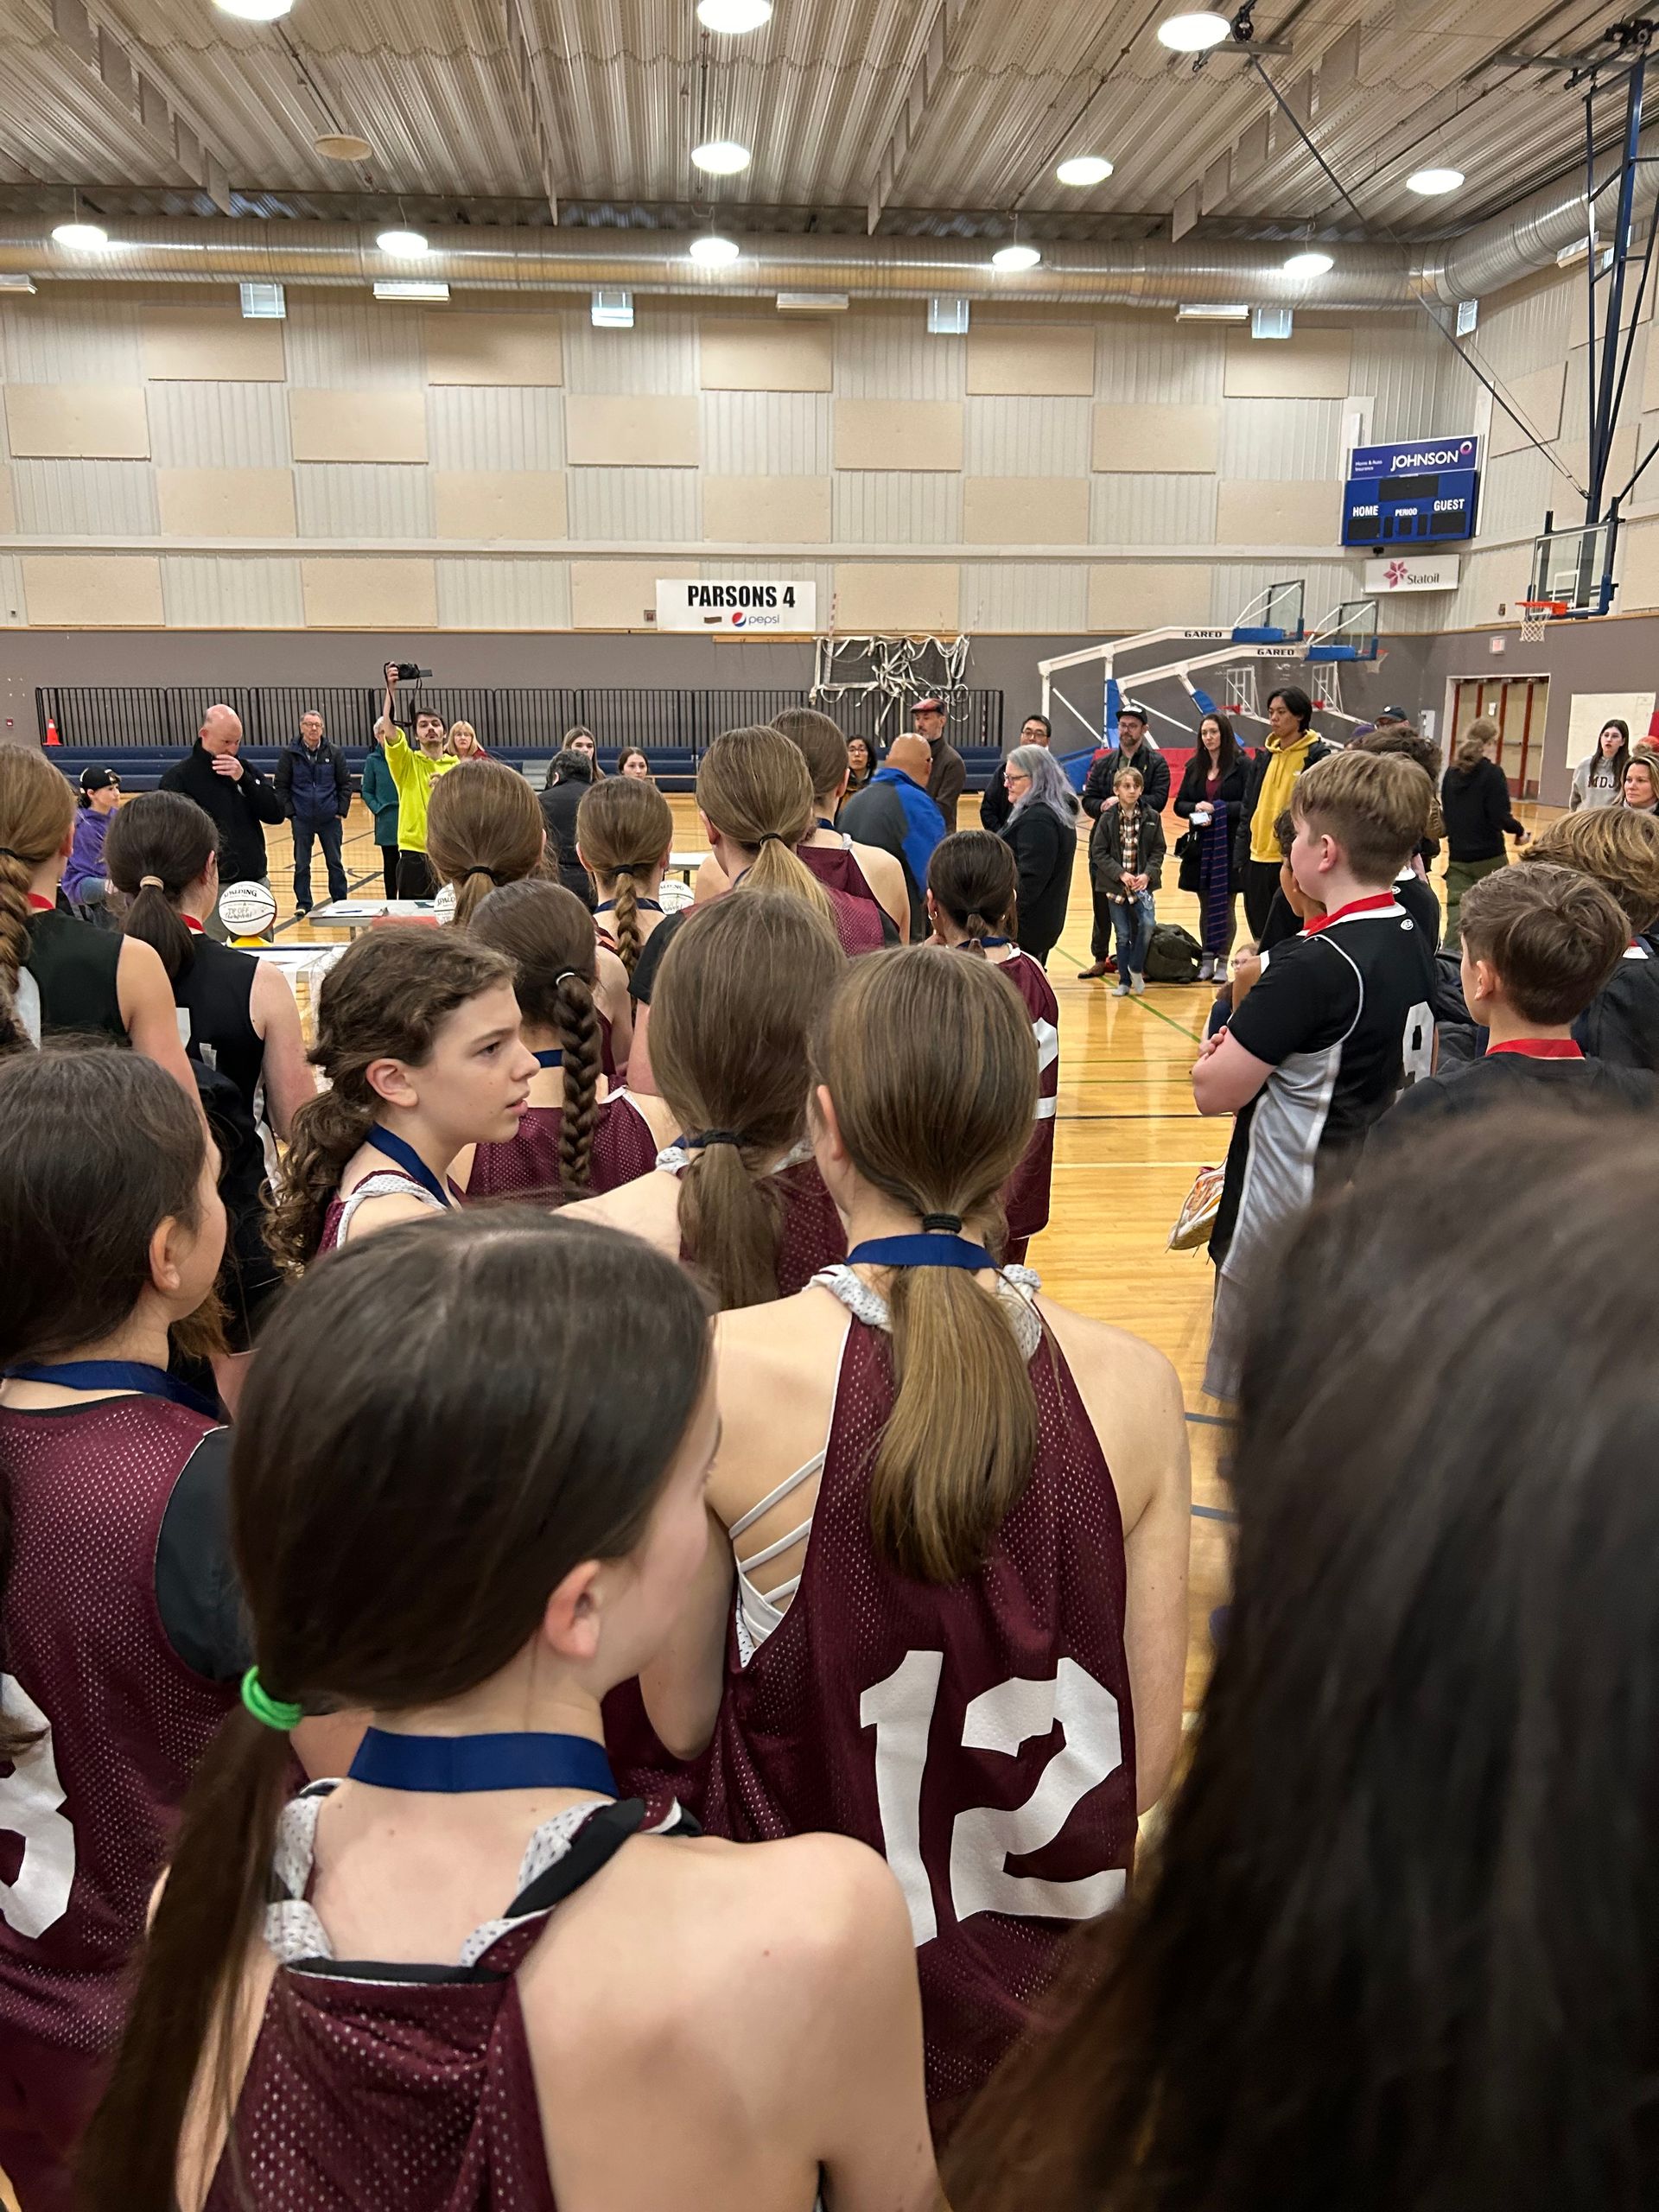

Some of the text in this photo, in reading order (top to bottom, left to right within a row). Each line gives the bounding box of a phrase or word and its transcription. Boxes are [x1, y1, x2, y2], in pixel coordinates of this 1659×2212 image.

[1390, 449, 1459, 472] JOHNSON
[1352, 505, 1379, 517] HOME
[1433, 499, 1465, 512] GUEST
[1395, 507, 1418, 517] PERIOD
[1407, 573, 1440, 585] Statoil
[688, 585, 795, 607] PARSONS 4
[748, 614, 780, 626] pepsi
[1185, 630, 1223, 639] GARED
[224, 889, 257, 898] SPALDING
[860, 1650, 1127, 1948] 12
